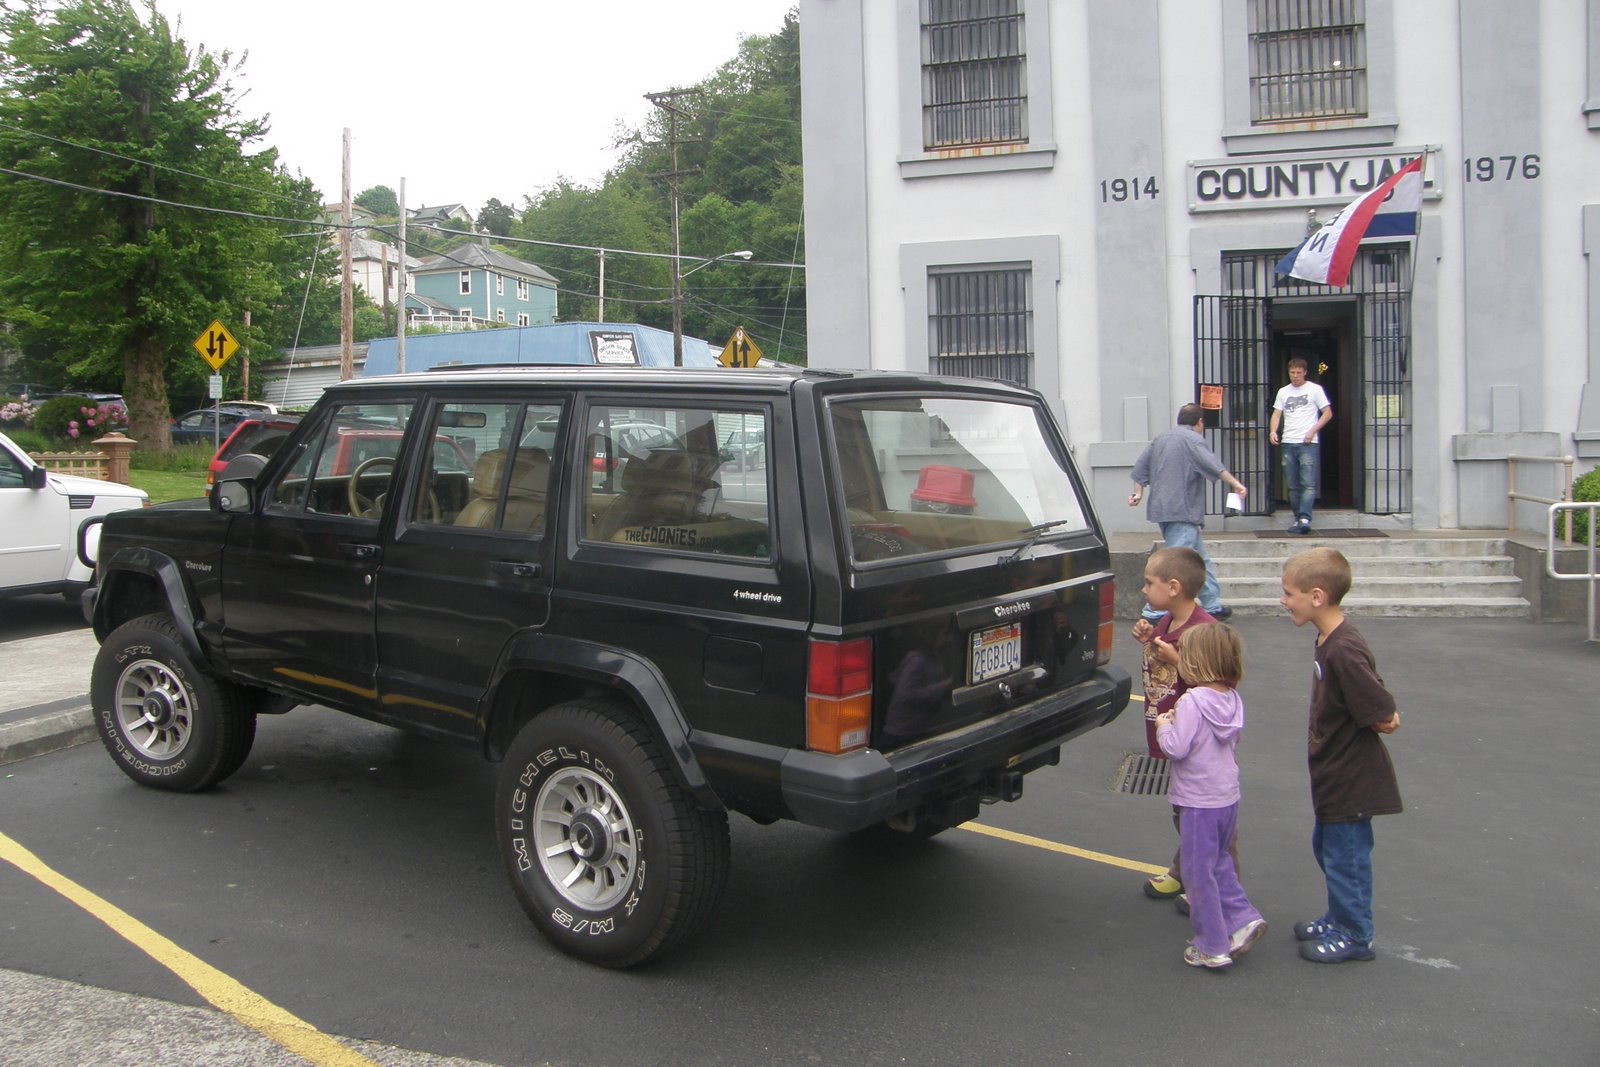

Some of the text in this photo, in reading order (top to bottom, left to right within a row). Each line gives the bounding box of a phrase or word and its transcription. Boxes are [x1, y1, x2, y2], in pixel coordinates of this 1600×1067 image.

[1197, 157, 1433, 200] COUNTY JA
[1464, 154, 1541, 183] 1976
[1100, 176, 1160, 203] 1914
[186, 560, 213, 572] Cherokee
[733, 589, 782, 603] 4 wheel drive
[994, 601, 1031, 617] Cherokee
[115, 645, 153, 663] LTX
[974, 639, 1019, 676] 2EGB104
[102, 711, 187, 776] MICHELIN
[512, 746, 614, 871] MICHELIN
[552, 908, 615, 935] M/S
